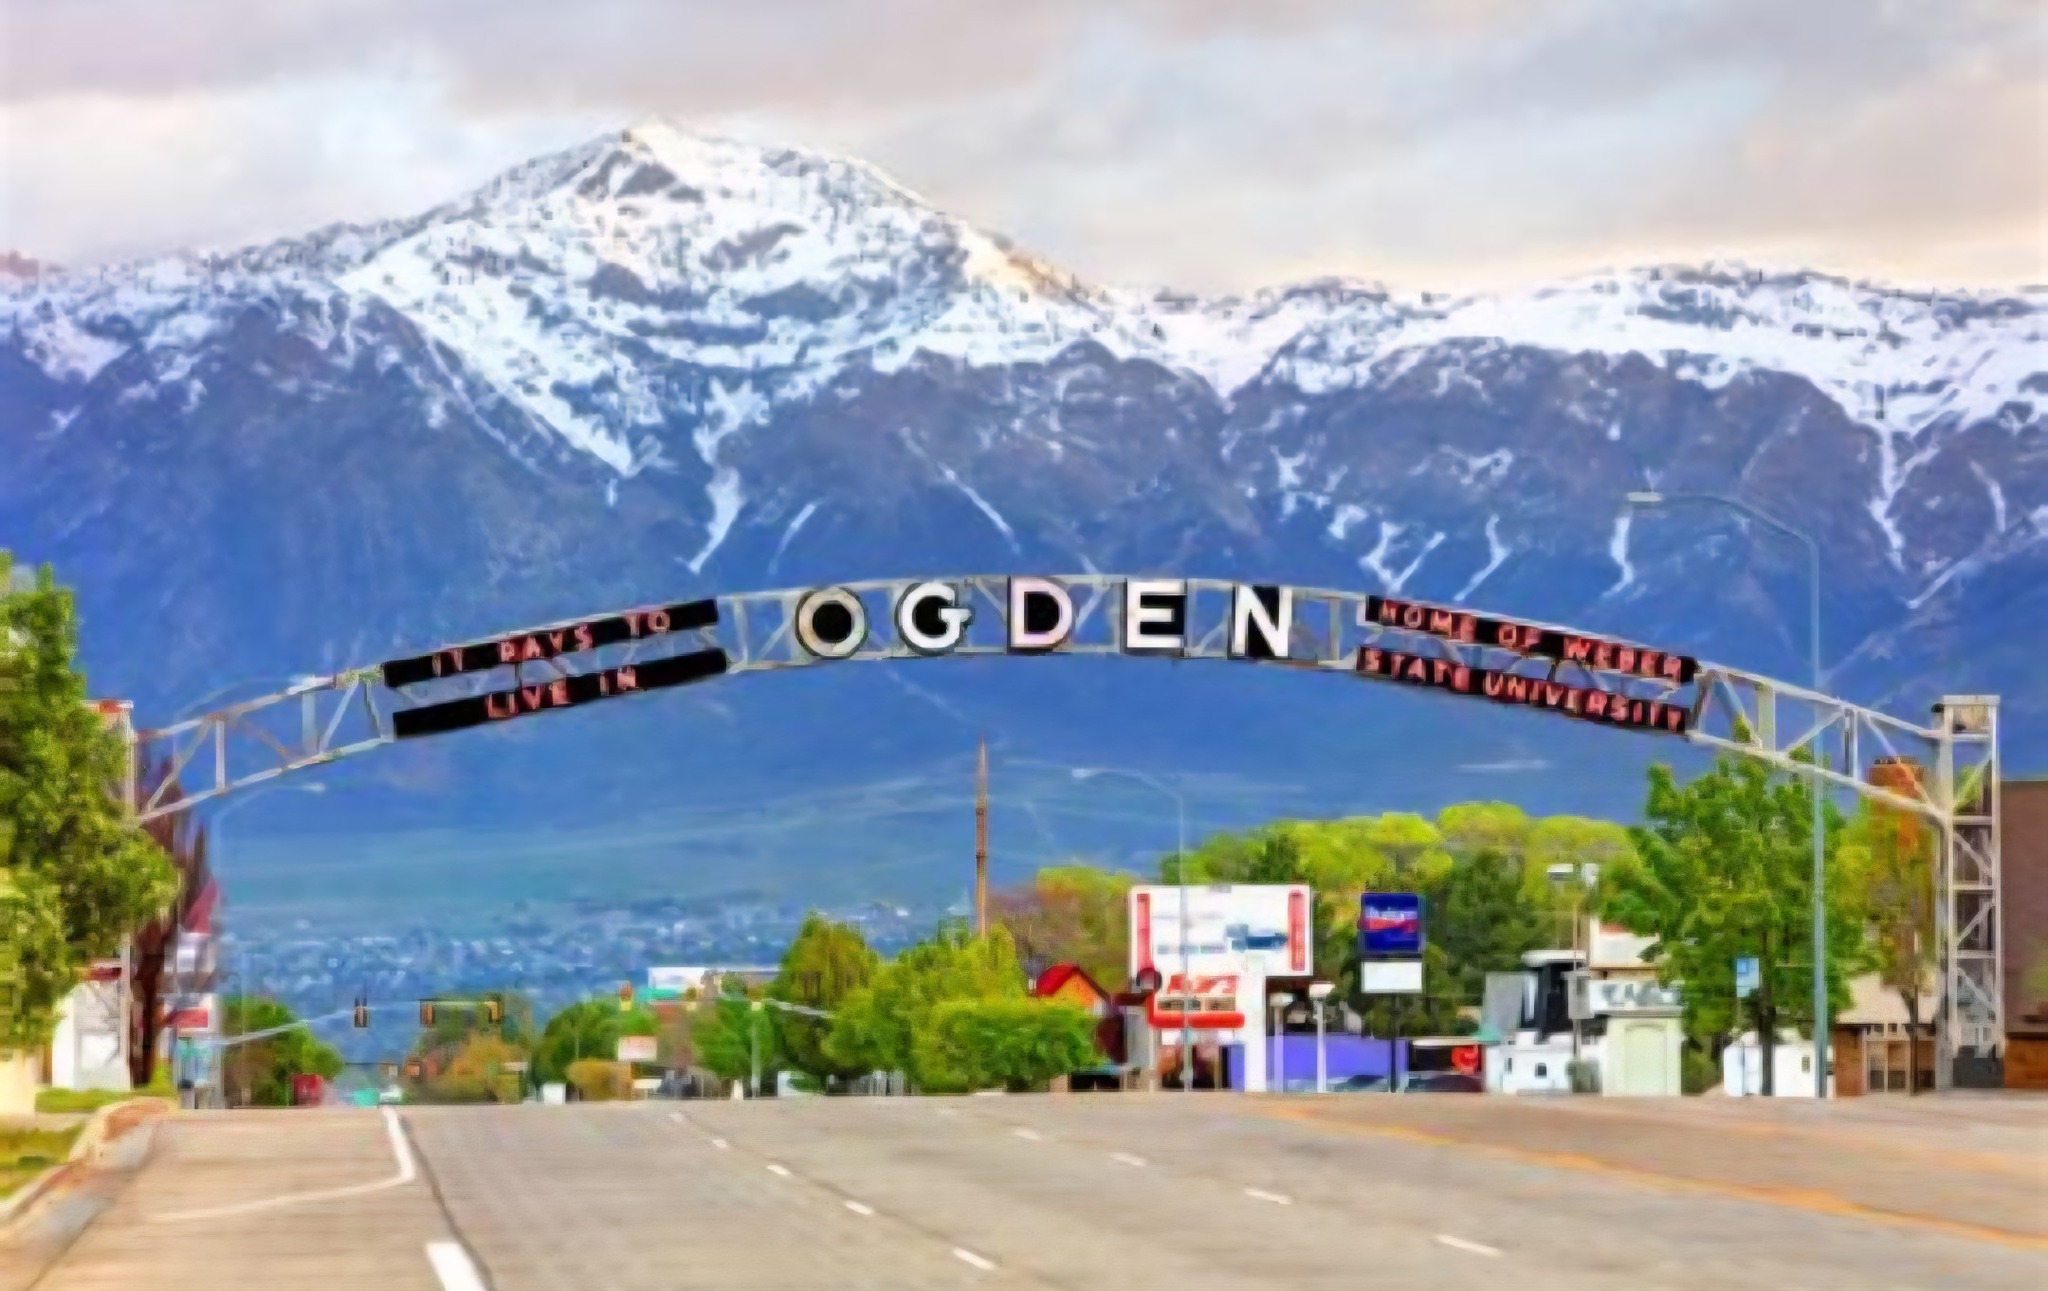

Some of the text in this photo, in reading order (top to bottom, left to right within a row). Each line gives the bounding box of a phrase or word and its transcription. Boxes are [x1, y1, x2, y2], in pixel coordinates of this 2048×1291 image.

[626, 610, 671, 638] TO
[795, 576, 1293, 658] OGDEN
[486, 677, 568, 718] LIVE
[1484, 670, 1682, 733] UNIVERSITY
